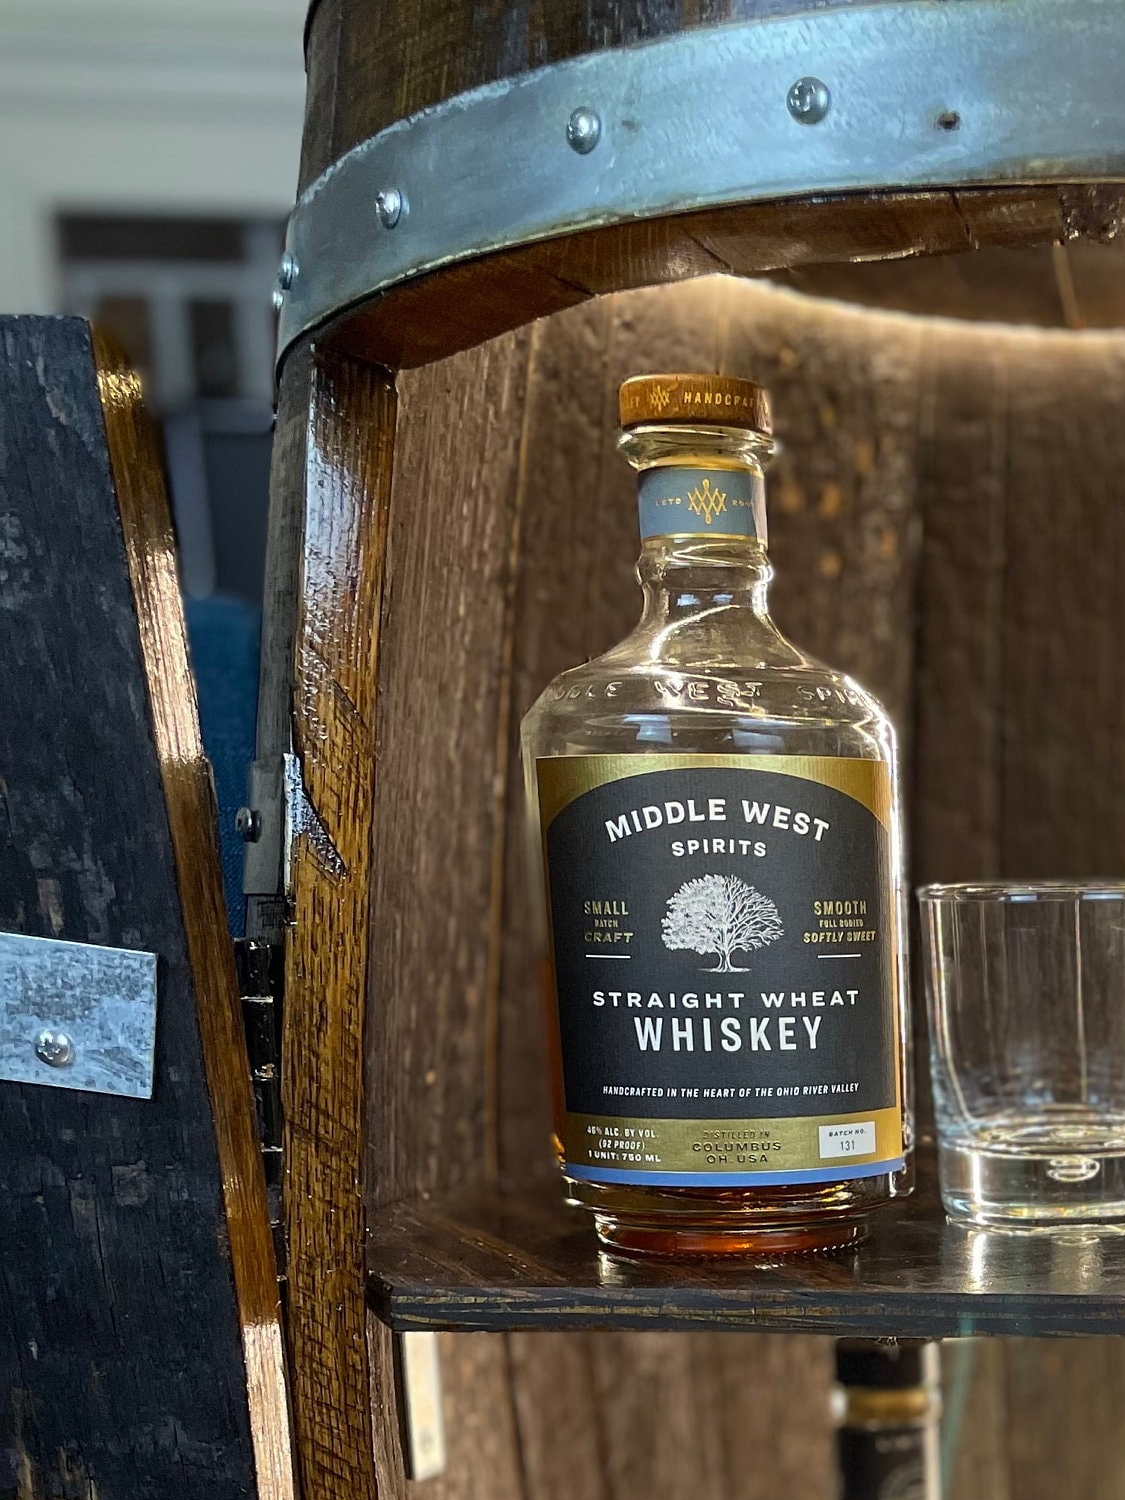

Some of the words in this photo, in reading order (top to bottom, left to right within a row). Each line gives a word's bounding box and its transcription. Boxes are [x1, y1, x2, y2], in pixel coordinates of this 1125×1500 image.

[605, 798, 727, 843] MIDDLE
[741, 800, 830, 843] WEST
[671, 838, 767, 857] SPIRITS
[584, 901, 629, 915] SMALL
[814, 900, 867, 915] SMOOTH
[594, 919, 618, 928] BATCH
[819, 919, 837, 928] FULL
[840, 919, 864, 928] BODIED
[584, 932, 634, 943] CRAFT
[803, 931, 844, 943] SOFTLY
[846, 930, 876, 942] SWEET
[593, 991, 745, 1009] STRAIGHT
[761, 990, 860, 1008] WHEAT
[634, 1016, 822, 1052] WHISKEY
[602, 1085, 664, 1097] HANDCRAFTED
[667, 1088, 678, 1098] IN
[680, 1088, 699, 1098] THE
[703, 1088, 736, 1099] HEART
[739, 1087, 752, 1098] OF
[754, 1087, 774, 1097] THE
[776, 1086, 800, 1097] OHIO
[802, 1084, 829, 1096] RIVER
[831, 1082, 860, 1095] VALLEY
[624, 1128, 635, 1138] BY
[702, 1129, 756, 1140] DISTILLED
[828, 1130, 853, 1138] BATCH
[599, 1138, 612, 1149] (92
[614, 1140, 645, 1151] PROOF)
[692, 1141, 781, 1152] COLUMBUS
[840, 1139, 855, 1151] 131
[622, 1153, 642, 1161] 750
[645, 1154, 661, 1163] ML
[736, 1152, 768, 1164] USA
